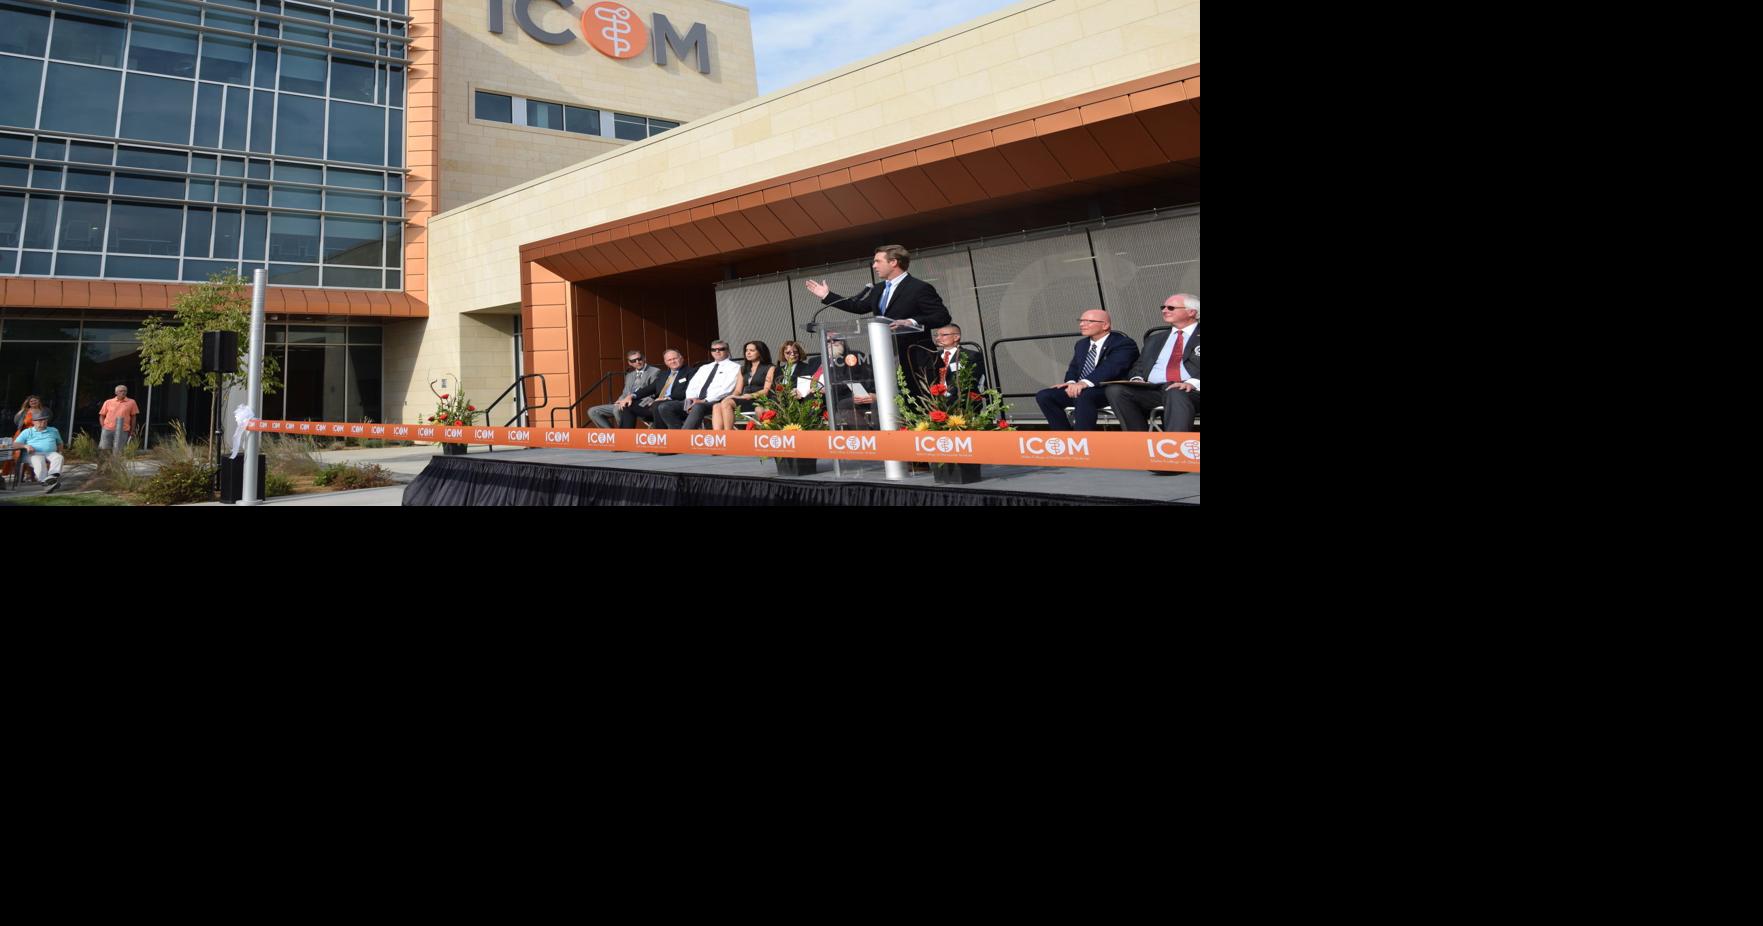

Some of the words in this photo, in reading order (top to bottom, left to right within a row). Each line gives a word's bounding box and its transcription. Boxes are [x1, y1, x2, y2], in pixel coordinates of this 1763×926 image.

[508, 430, 530, 441] ICOM
[546, 432, 570, 442] ICOM
[588, 432, 615, 444] ICOM
[635, 433, 666, 446] ICOM
[690, 434, 727, 447] ICOM
[753, 434, 796, 449] ICOM
[828, 435, 877, 450] ICOM
[914, 436, 973, 453] ICOM
[1018, 436, 1090, 456] ICOM
[1146, 438, 1200, 460] ICO
